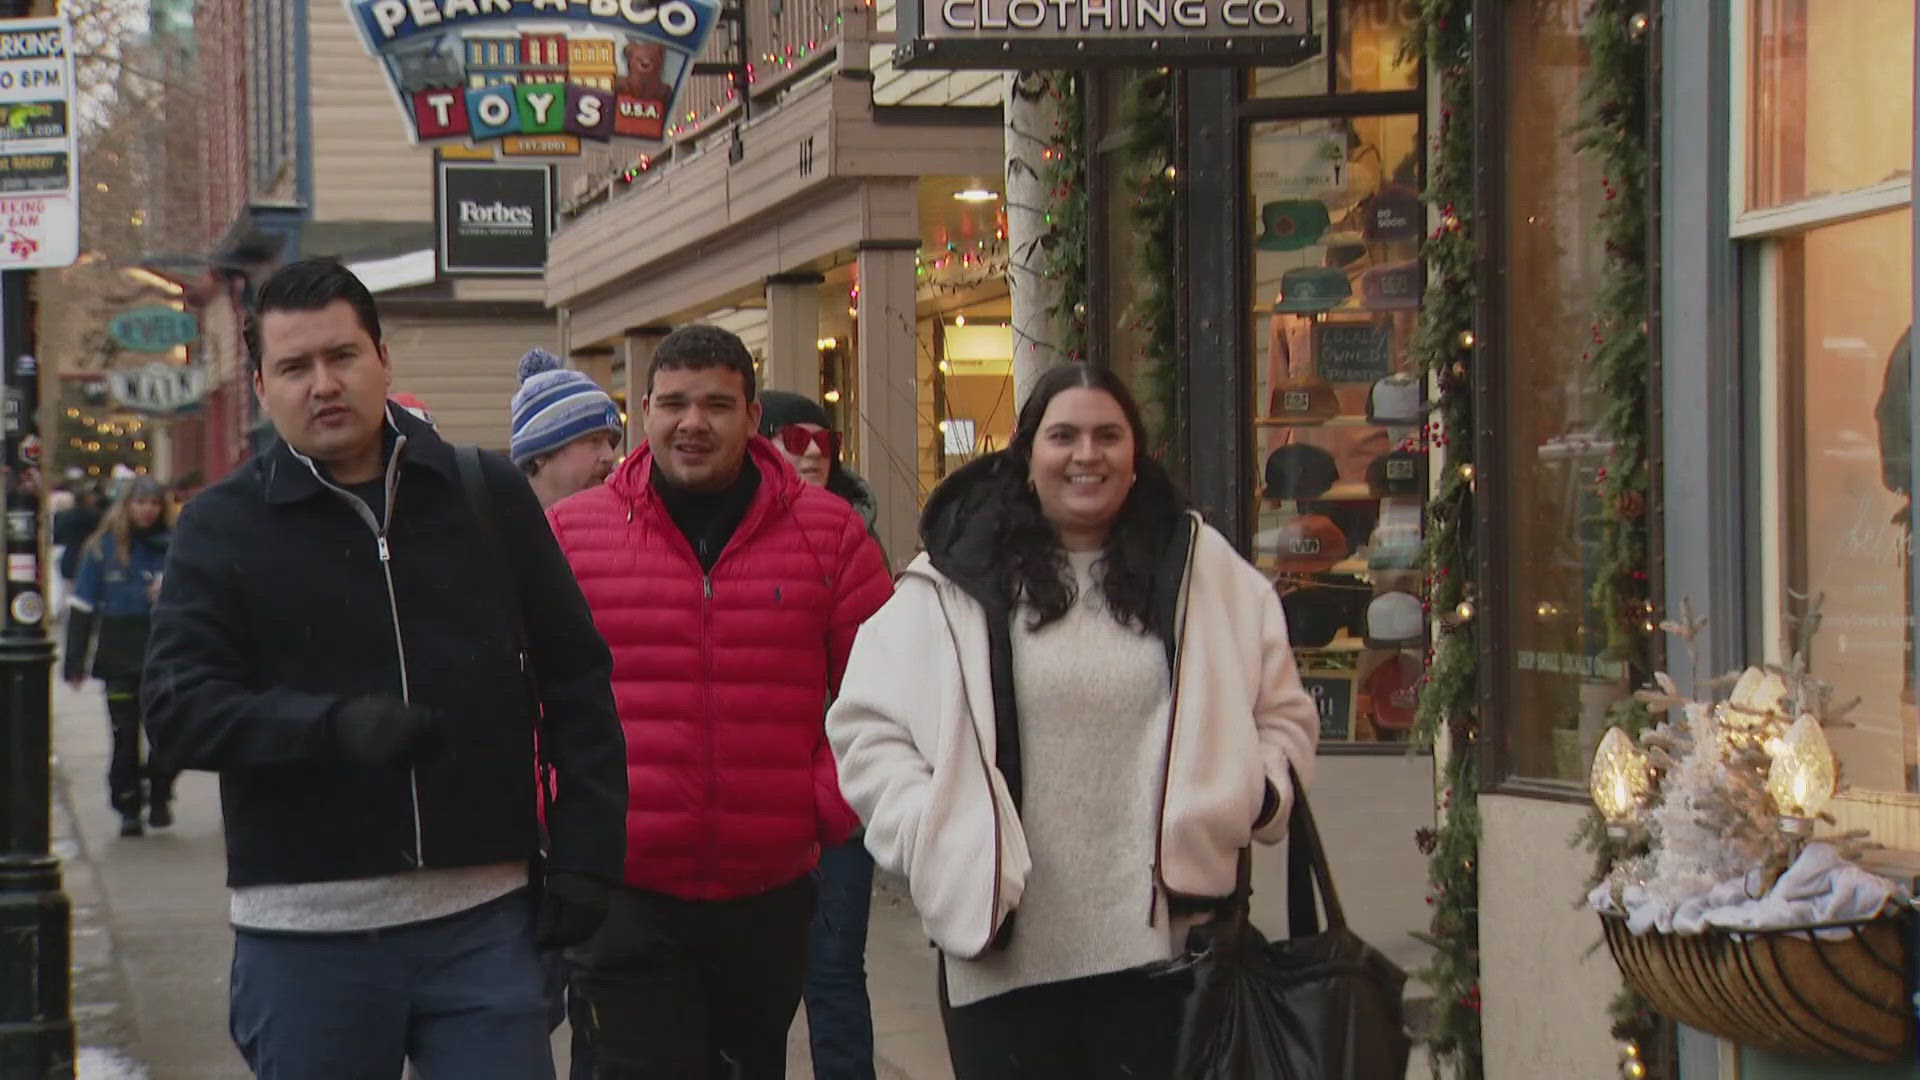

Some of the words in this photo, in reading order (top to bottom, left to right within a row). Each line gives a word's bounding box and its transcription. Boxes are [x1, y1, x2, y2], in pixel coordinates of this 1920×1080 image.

[942, 0, 1206, 28] CLOTHING
[1222, 0, 1294, 25] CO.
[427, 94, 601, 128] TOYS
[620, 102, 660, 119] U.S.A.
[460, 200, 532, 221] Forbes
